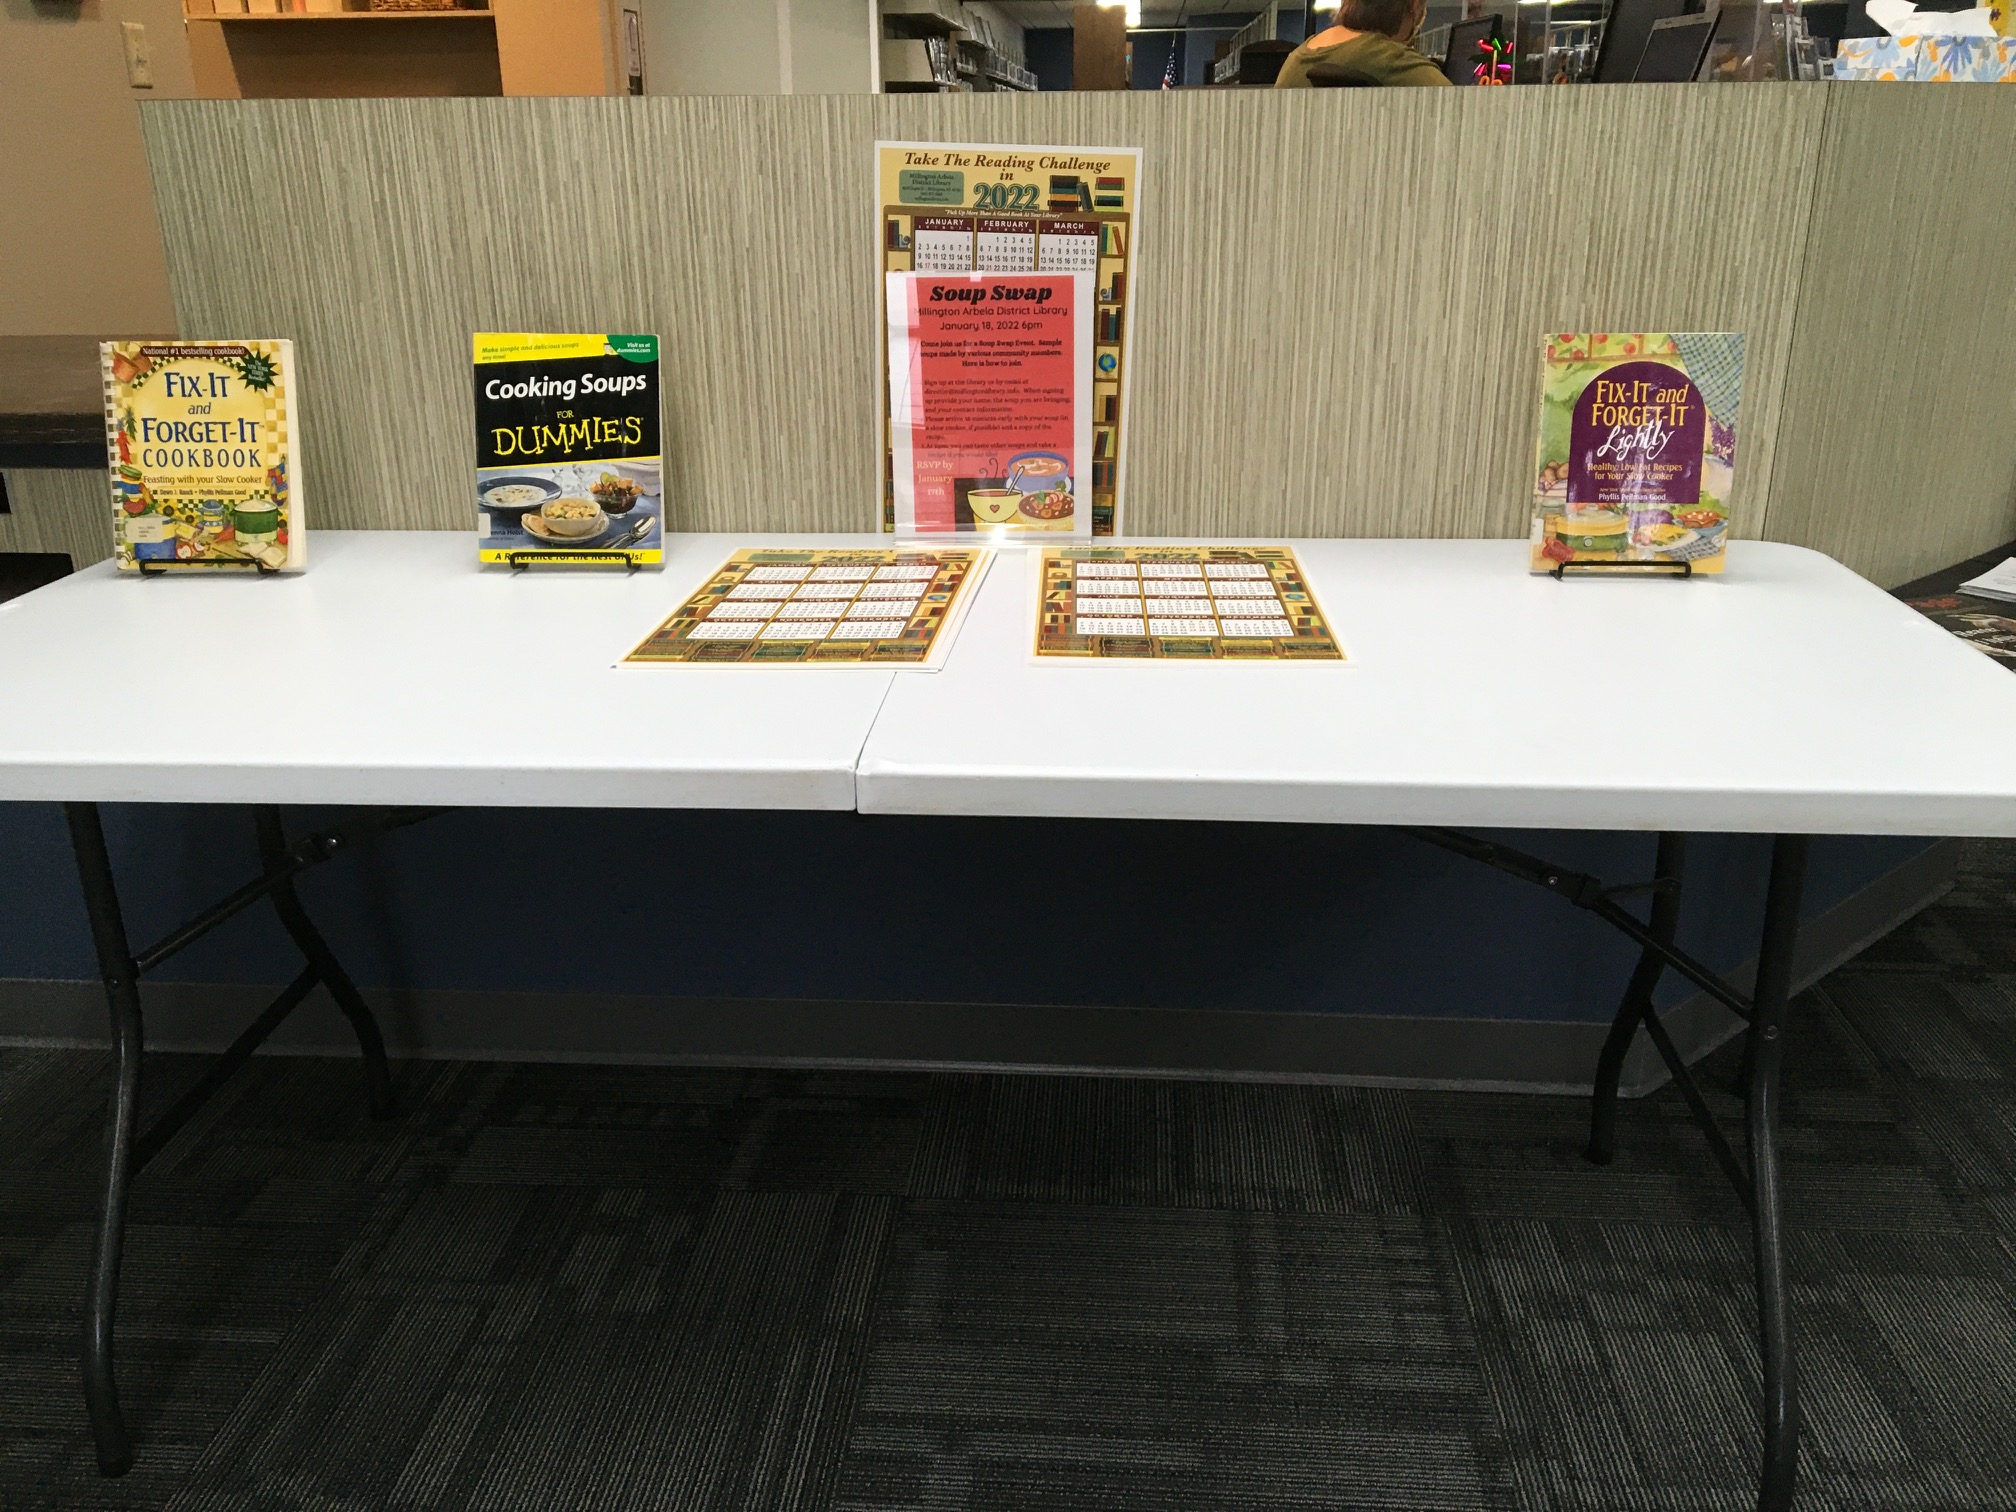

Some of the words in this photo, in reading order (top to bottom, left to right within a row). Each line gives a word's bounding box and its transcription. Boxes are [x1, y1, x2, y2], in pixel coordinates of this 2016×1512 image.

[905, 152, 939, 166] Take
[943, 153, 971, 167] The
[974, 154, 1035, 172] Reading
[1039, 156, 1111, 174] Challenge
[999, 168, 1014, 182] in
[973, 182, 1041, 212] 2022
[924, 218, 964, 226] JANUARY
[984, 220, 1030, 228] FEBRUARY
[1053, 222, 1085, 230] MARCH
[929, 285, 987, 305] Soup
[990, 284, 1053, 306] Swap
[962, 306, 994, 316] Arbela
[997, 306, 1031, 316] District
[1033, 306, 1068, 317] Library
[939, 321, 979, 332] January
[981, 321, 994, 331] 18,
[996, 321, 1020, 330] 2022
[1021, 320, 1043, 331] 6pm
[500, 345, 520, 354] simple
[534, 343, 560, 351] delicious
[940, 340, 953, 348] join
[979, 340, 995, 348] Soup
[996, 340, 1015, 348] Swap
[1039, 339, 1062, 347] Sample
[142, 347, 169, 355] National
[170, 347, 179, 355] #1
[180, 347, 213, 357] bestselling
[214, 347, 245, 356] cookbook!
[992, 350, 1029, 358] community
[164, 372, 231, 398] FIX-IT
[485, 375, 577, 401] Cooking
[580, 373, 647, 397] Soups
[1596, 380, 1652, 404] FIX-IT
[1655, 383, 1690, 404] and
[188, 402, 212, 415] and
[556, 410, 574, 419] FOR
[491, 416, 643, 456] DUMMIES
[1596, 418, 1676, 461] Lightly
[142, 448, 262, 468] COOKBOOK
[916, 460, 941, 469] RSVP
[942, 460, 954, 472] by
[1653, 462, 1683, 473] Recipes
[143, 475, 176, 486] Feasting
[176, 475, 195, 484] with
[196, 476, 214, 486] your
[216, 475, 235, 484] Slow
[236, 475, 262, 484] Cooker
[917, 473, 954, 484] January
[1594, 472, 1605, 480] for
[1607, 472, 1625, 480] Your
[1646, 472, 1674, 480] Cooker
[927, 486, 945, 497] 17th
[1598, 493, 1620, 502] Phyllis
[1649, 493, 1667, 501] Good
[494, 552, 502, 561] A
[504, 552, 553, 561] Rerence
[1134, 552, 1200, 560] 2022
